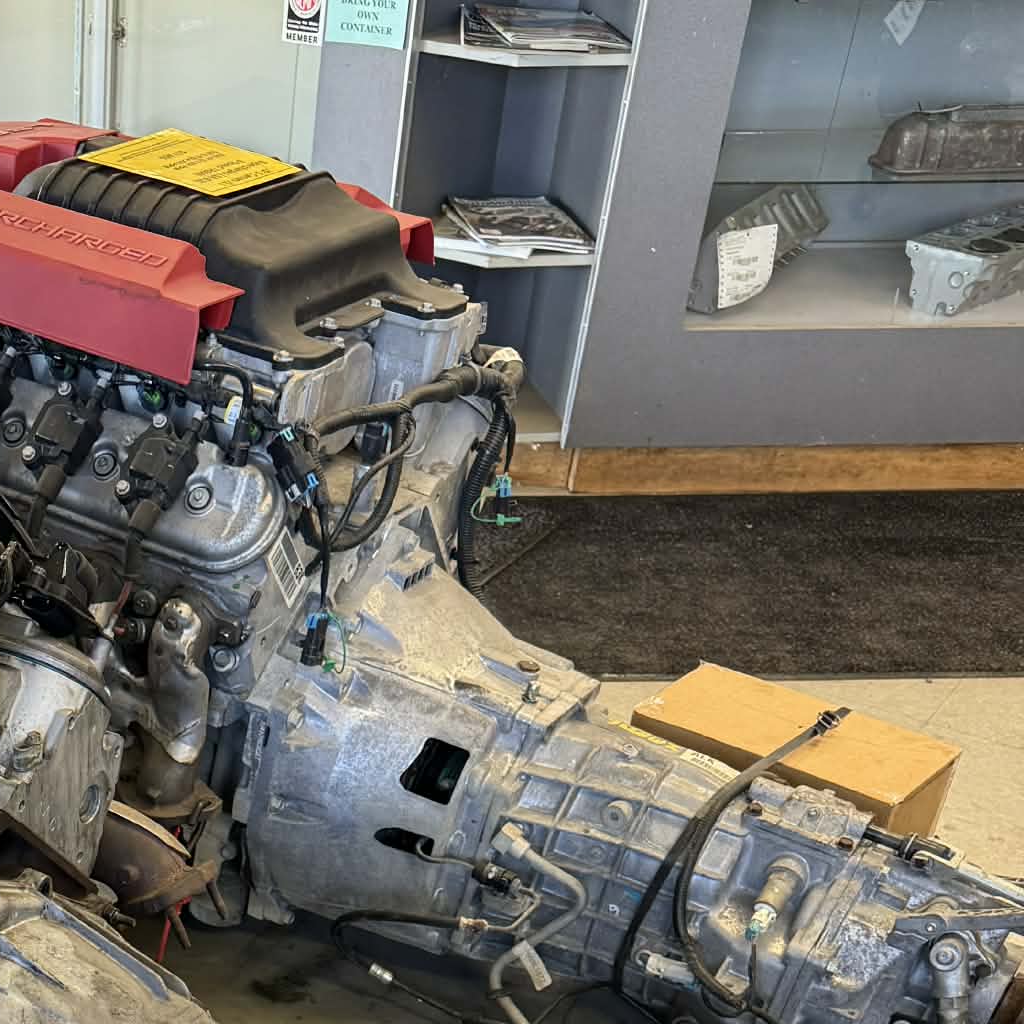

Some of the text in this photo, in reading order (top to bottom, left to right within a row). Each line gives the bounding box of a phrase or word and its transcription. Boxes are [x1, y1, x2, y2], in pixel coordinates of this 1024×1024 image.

[357, 10, 379, 21] OWN
[340, 22, 392, 35] CONTAINER
[286, 32, 318, 43] MEMBER
